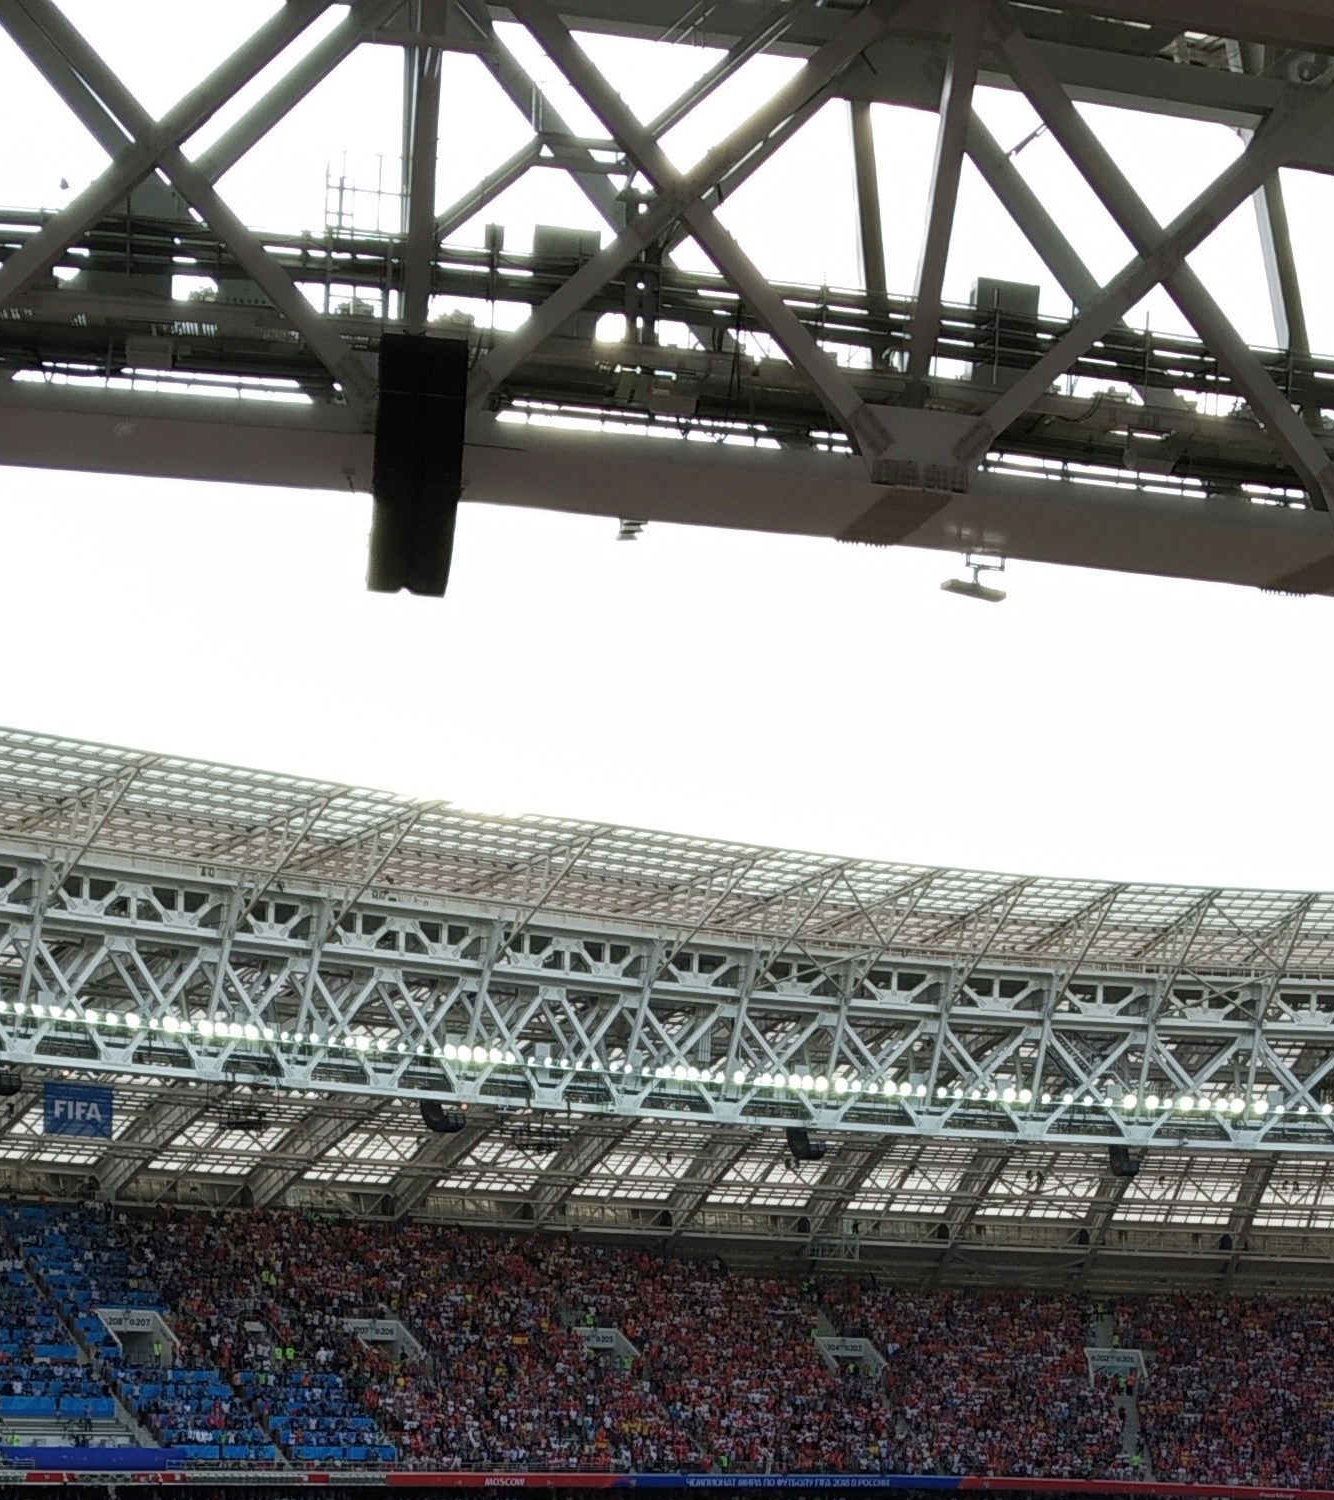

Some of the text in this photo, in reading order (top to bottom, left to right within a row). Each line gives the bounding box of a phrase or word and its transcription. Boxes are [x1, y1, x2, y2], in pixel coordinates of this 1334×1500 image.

[54, 1099, 102, 1121] FIFA
[135, 1318, 150, 1327] 207
[380, 1327, 394, 1335] 206
[485, 1477, 525, 1486] MOSCOW
[686, 1477, 736, 1487] ЧЕМПИОНАТ
[738, 1478, 762, 1487] МИРА
[763, 1478, 774, 1487] ПО
